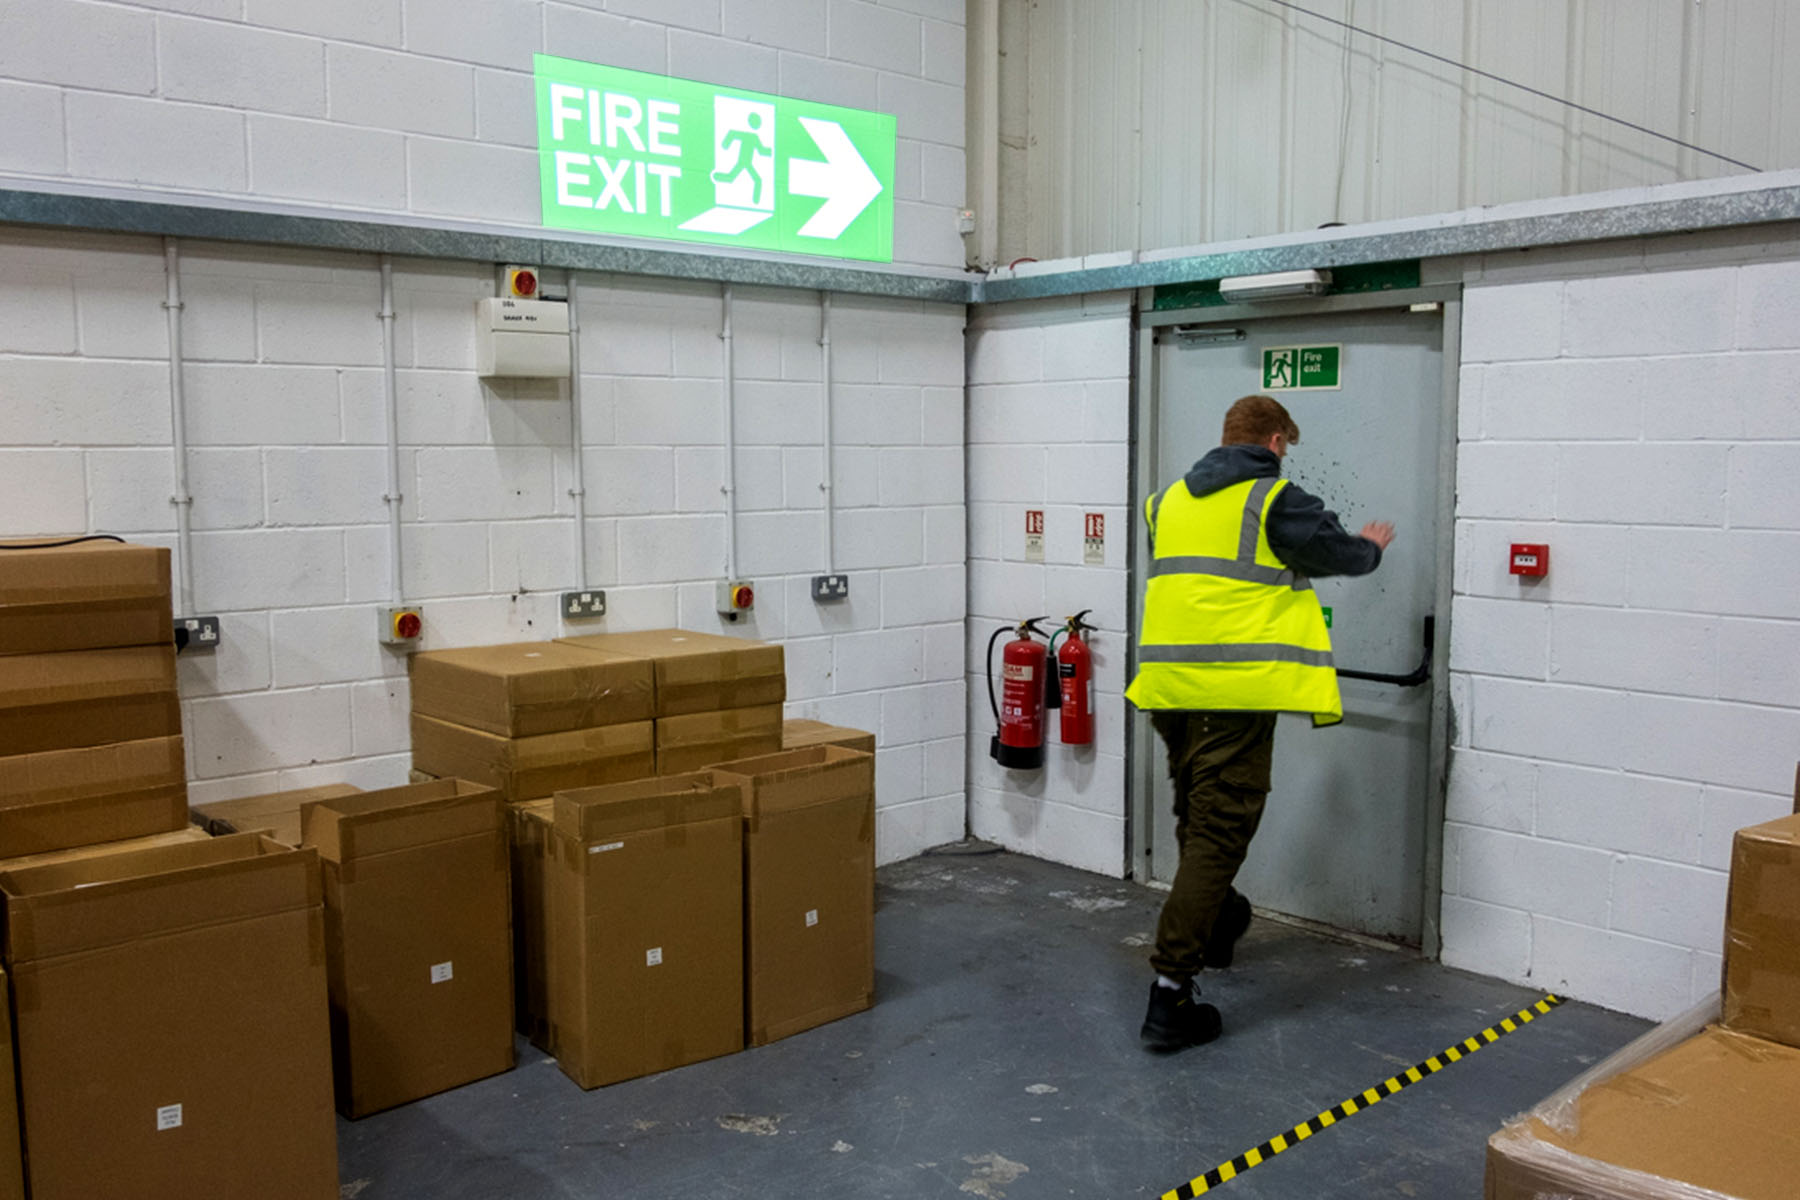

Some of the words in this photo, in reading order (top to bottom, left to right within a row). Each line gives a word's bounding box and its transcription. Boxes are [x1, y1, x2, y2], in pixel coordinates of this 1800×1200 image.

[550, 83, 681, 157] FIRE
[555, 150, 682, 217] EXIT
[1304, 352, 1322, 362] Fire
[1304, 363, 1321, 373] exit
